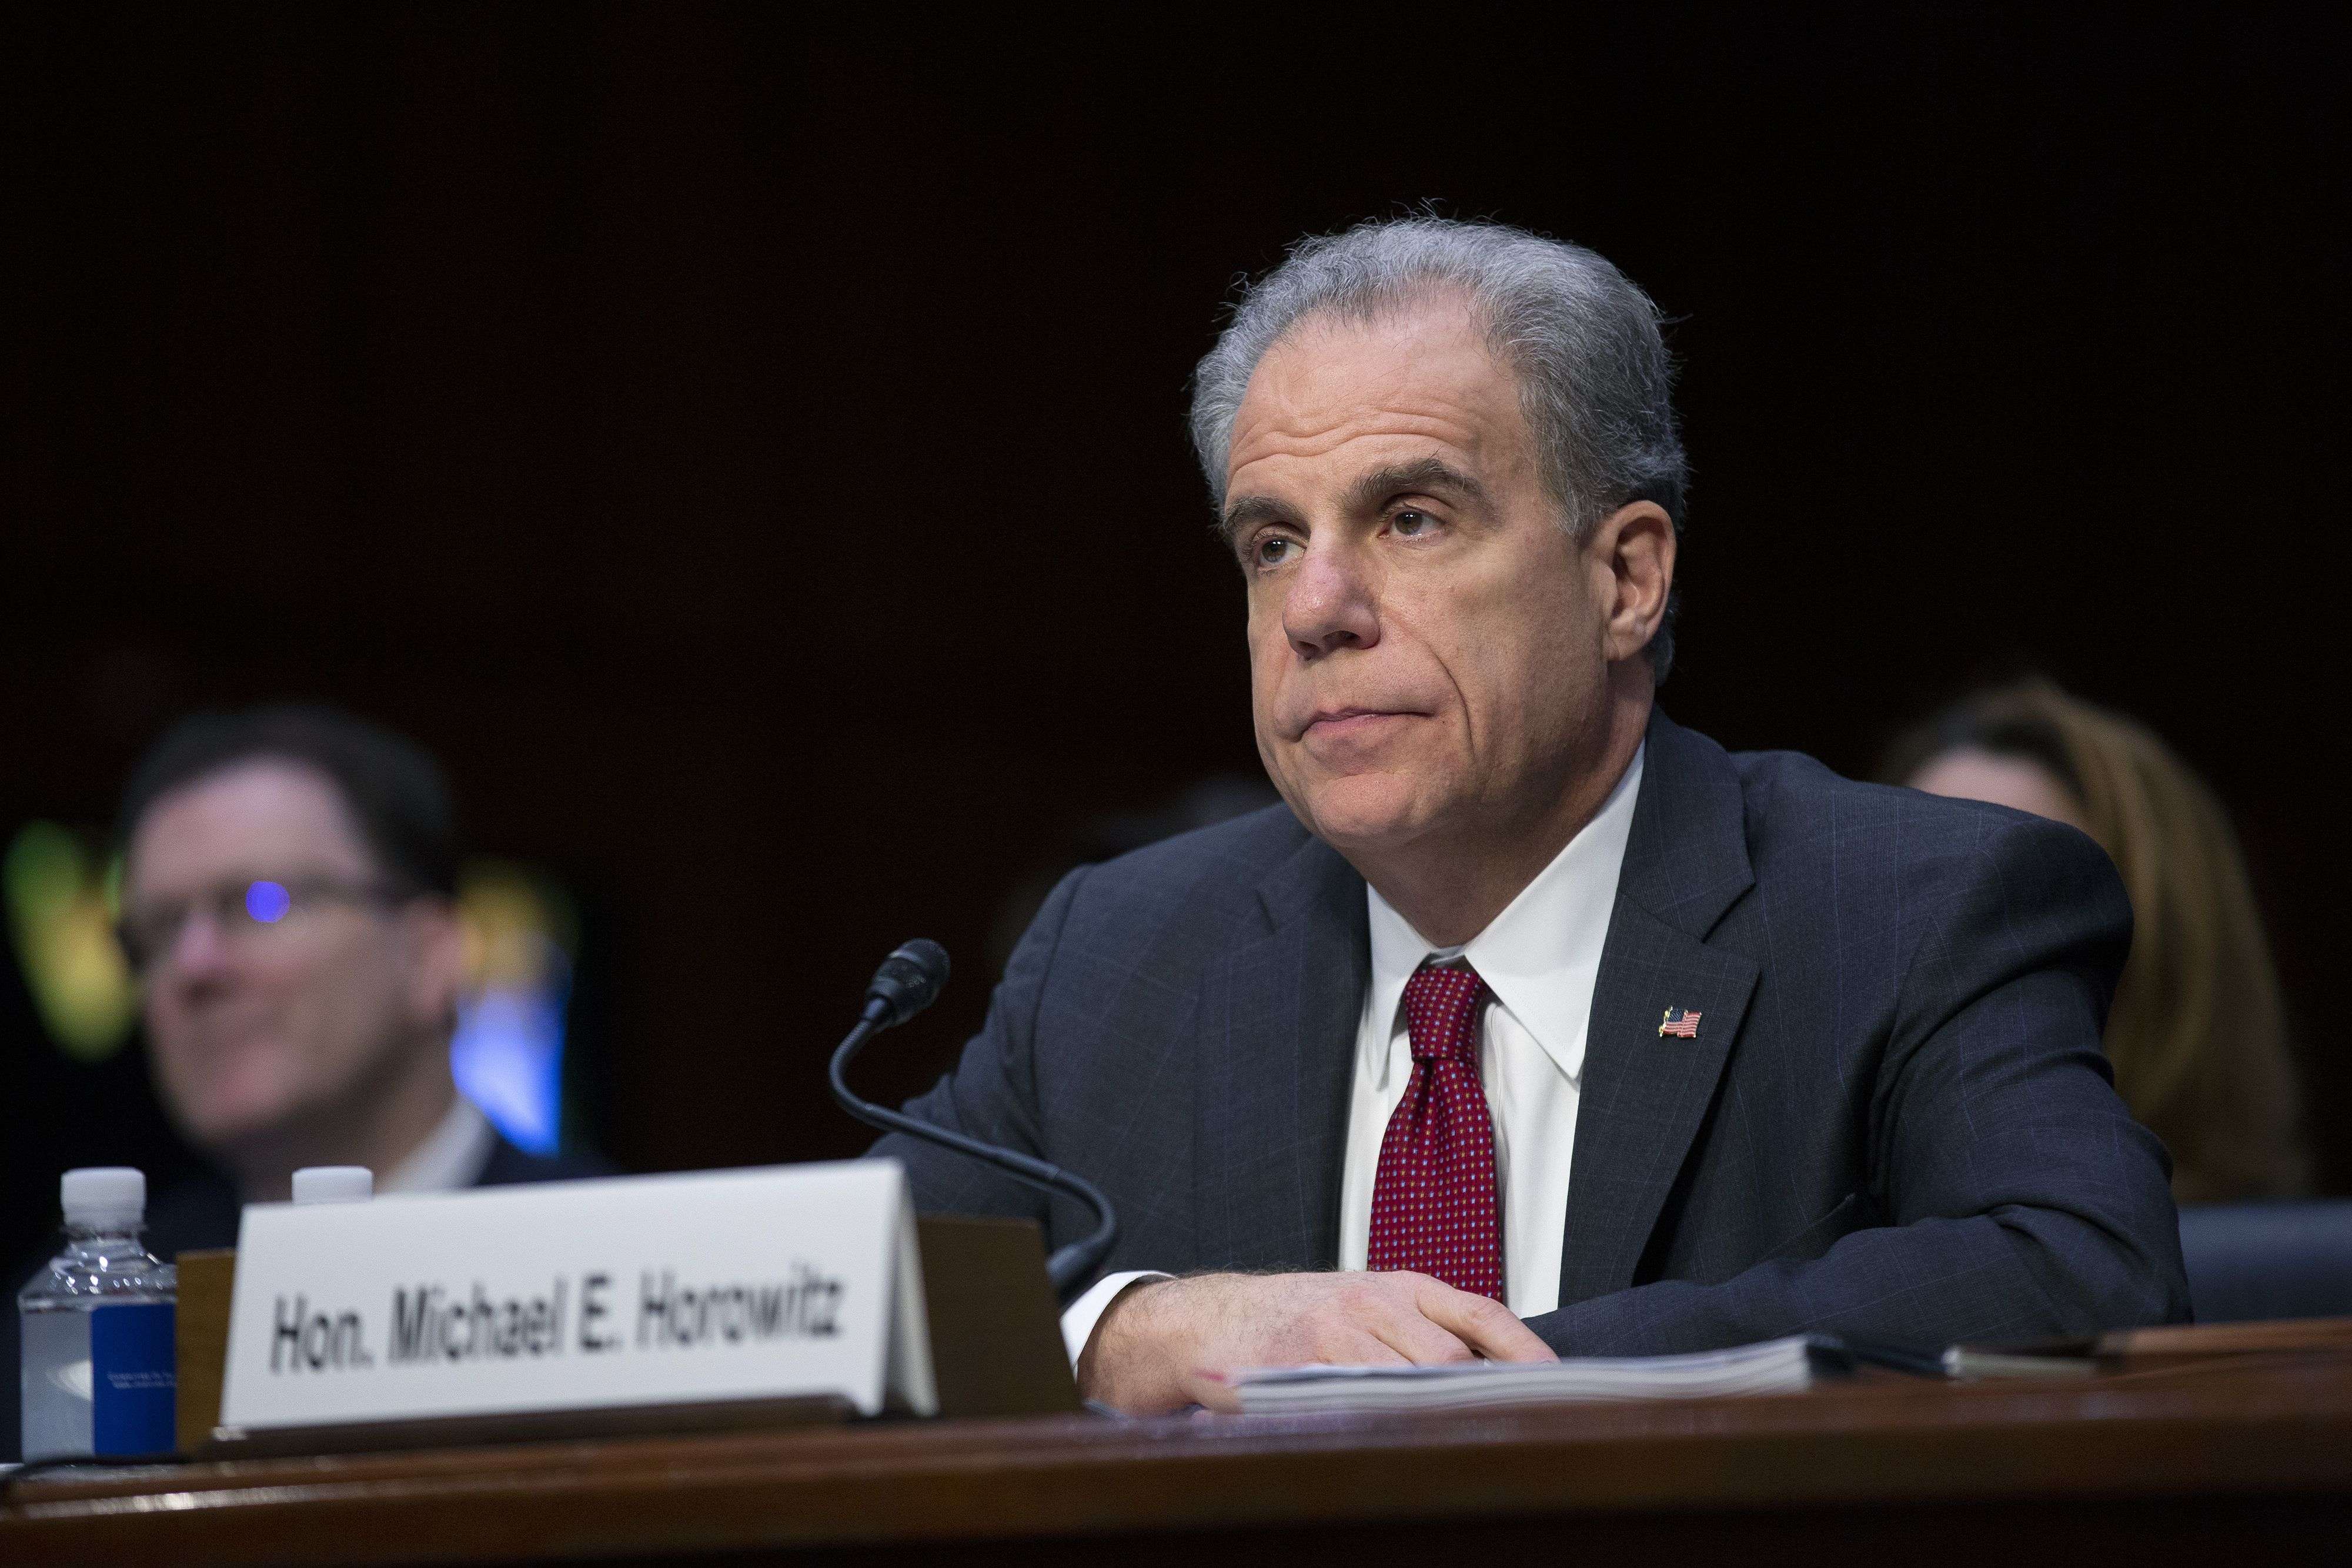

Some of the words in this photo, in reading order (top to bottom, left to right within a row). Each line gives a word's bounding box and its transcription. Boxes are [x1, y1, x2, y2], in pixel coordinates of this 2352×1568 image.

[270, 1292, 373, 1372] Hon.
[389, 1273, 569, 1365] Michael
[580, 1271, 623, 1353] E.
[636, 1259, 845, 1349] Horowitz
